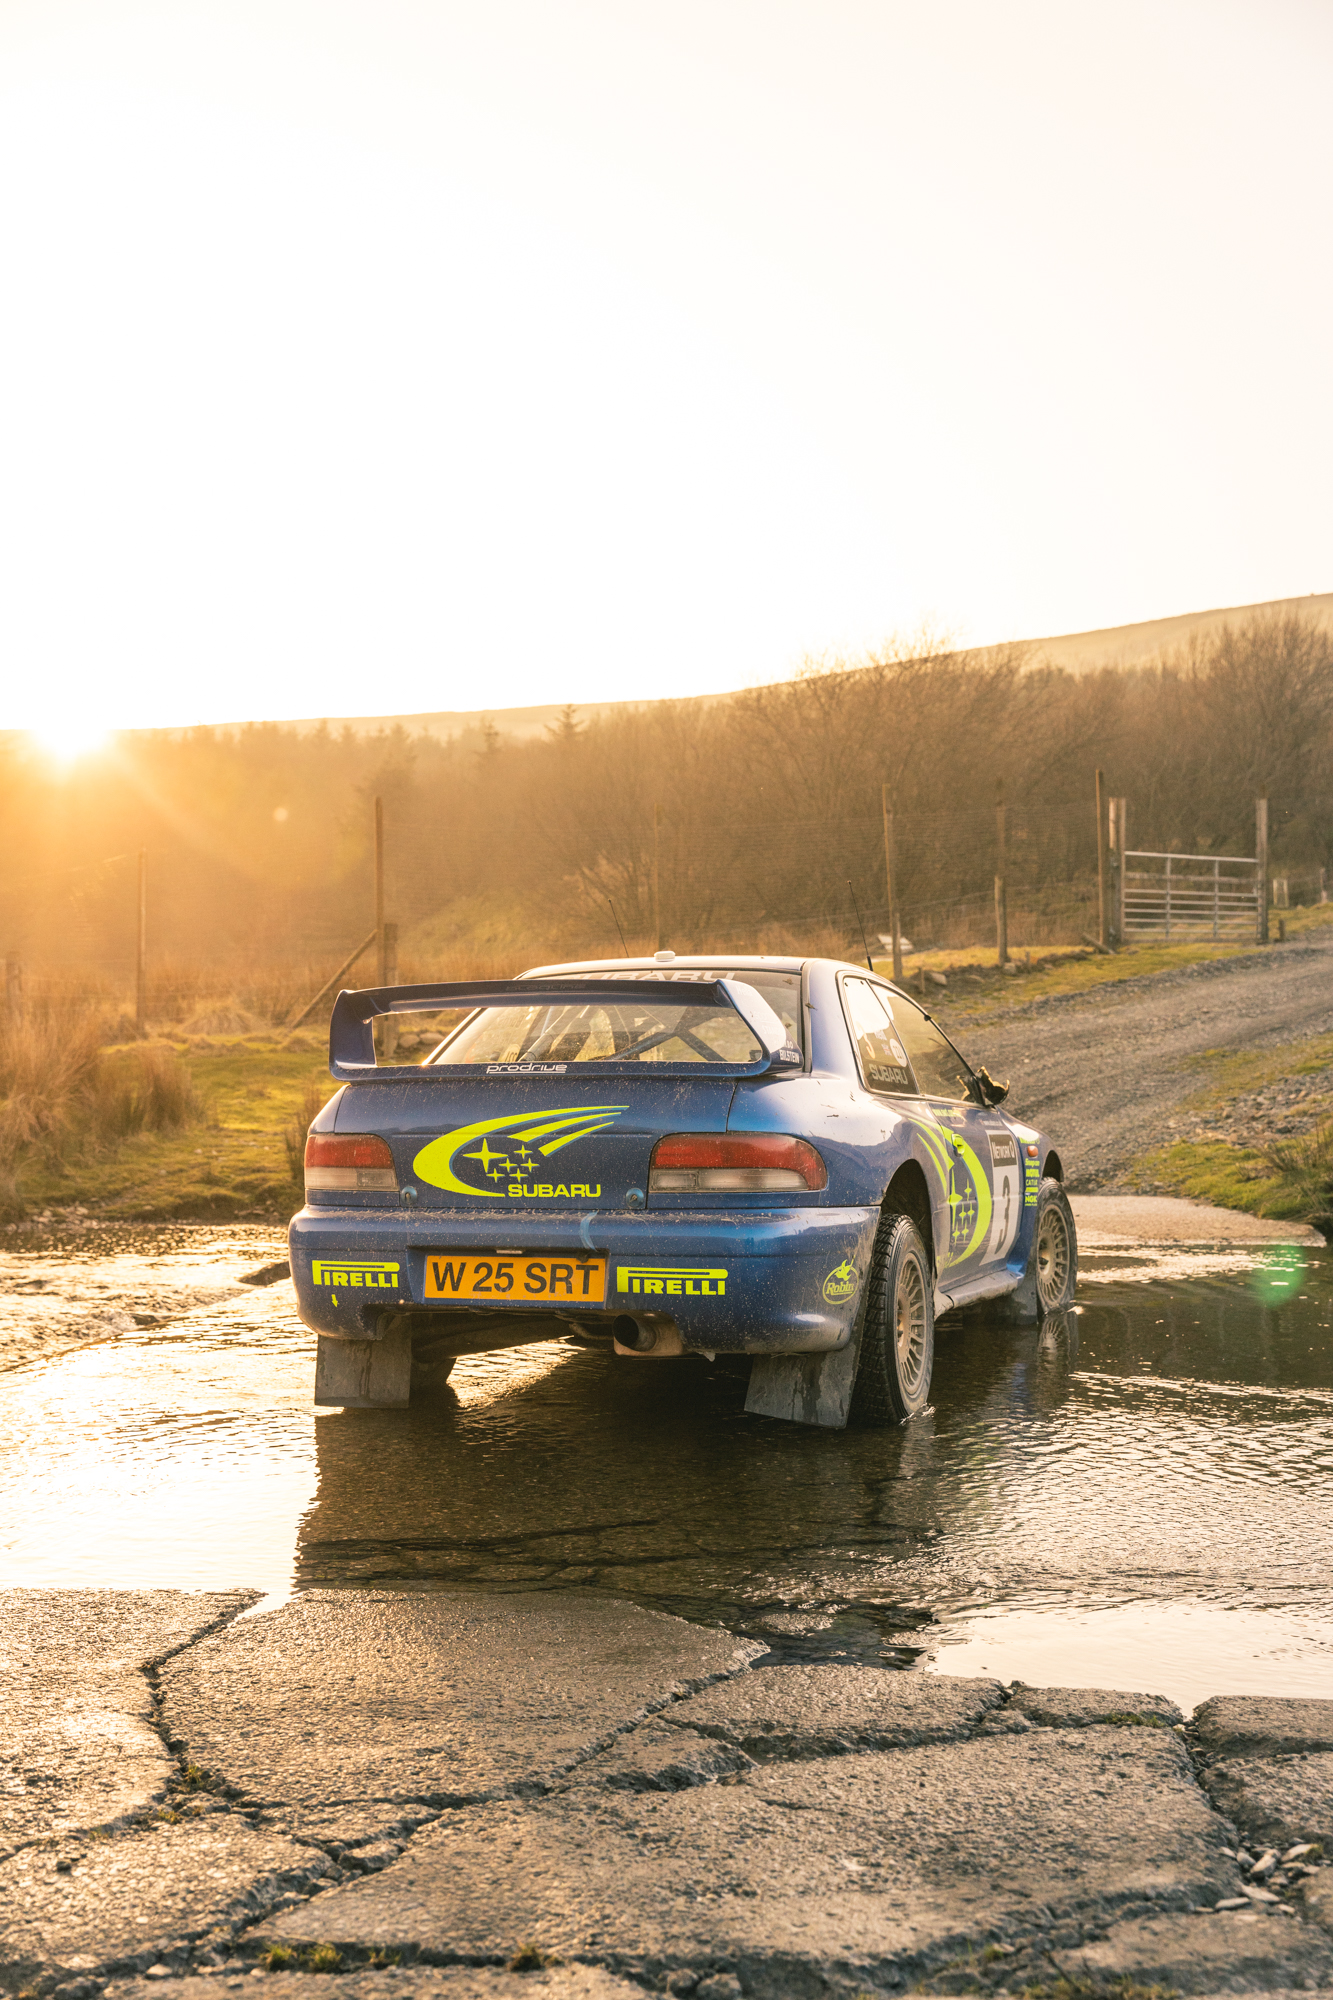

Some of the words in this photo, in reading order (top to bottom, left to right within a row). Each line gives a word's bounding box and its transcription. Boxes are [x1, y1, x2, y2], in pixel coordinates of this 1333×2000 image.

[571, 971, 736, 981] UBARU
[486, 1063, 568, 1074] prodrive
[868, 1064, 908, 1085] SUBARU
[507, 1184, 601, 1198] SUBARU
[312, 1260, 400, 1288] PIRELLI
[432, 1262, 467, 1292] W
[473, 1262, 514, 1293] 25
[523, 1263, 599, 1295] SRT
[616, 1266, 729, 1296] PIRELLI
[825, 1281, 855, 1296] Robin
